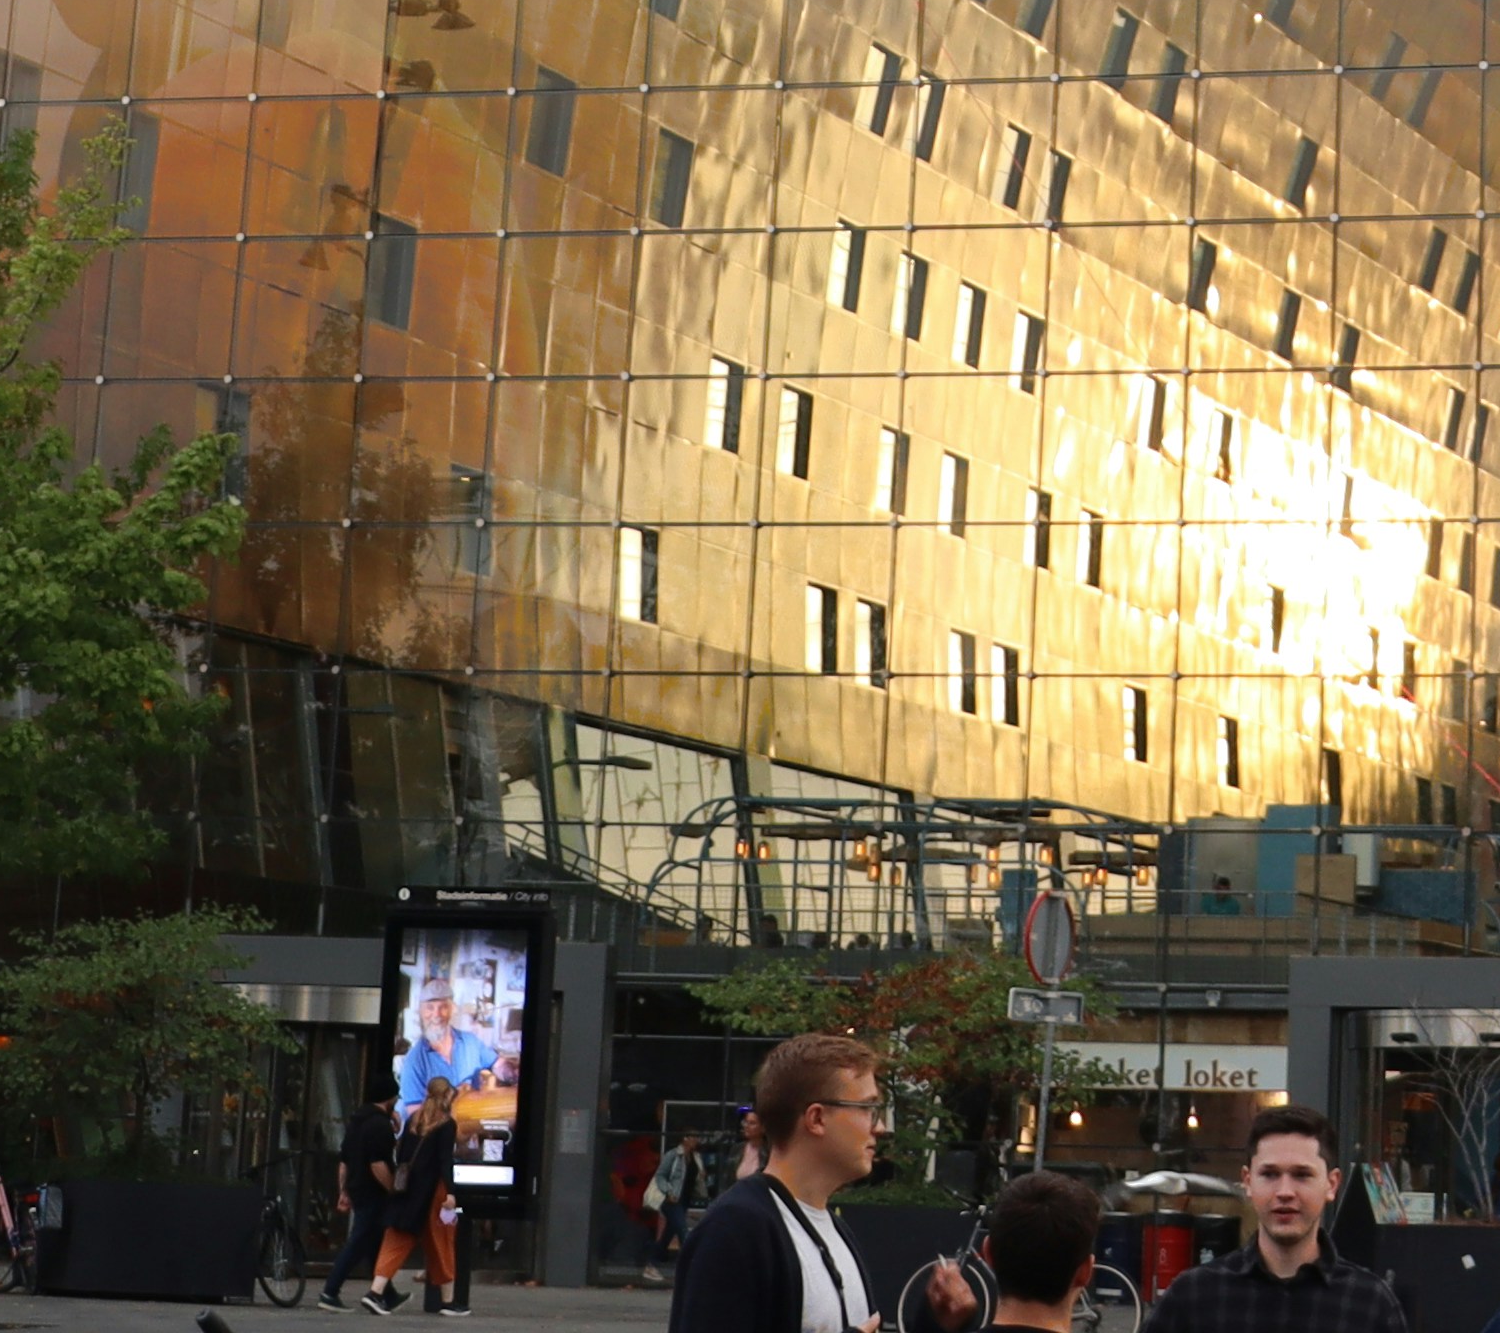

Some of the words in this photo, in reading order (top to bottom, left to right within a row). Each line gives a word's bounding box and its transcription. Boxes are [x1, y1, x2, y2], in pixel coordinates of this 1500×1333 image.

[436, 890, 508, 901] Stadsinformatie
[515, 891, 531, 902] City
[532, 892, 549, 902] info
[1185, 1060, 1258, 1087] loket
